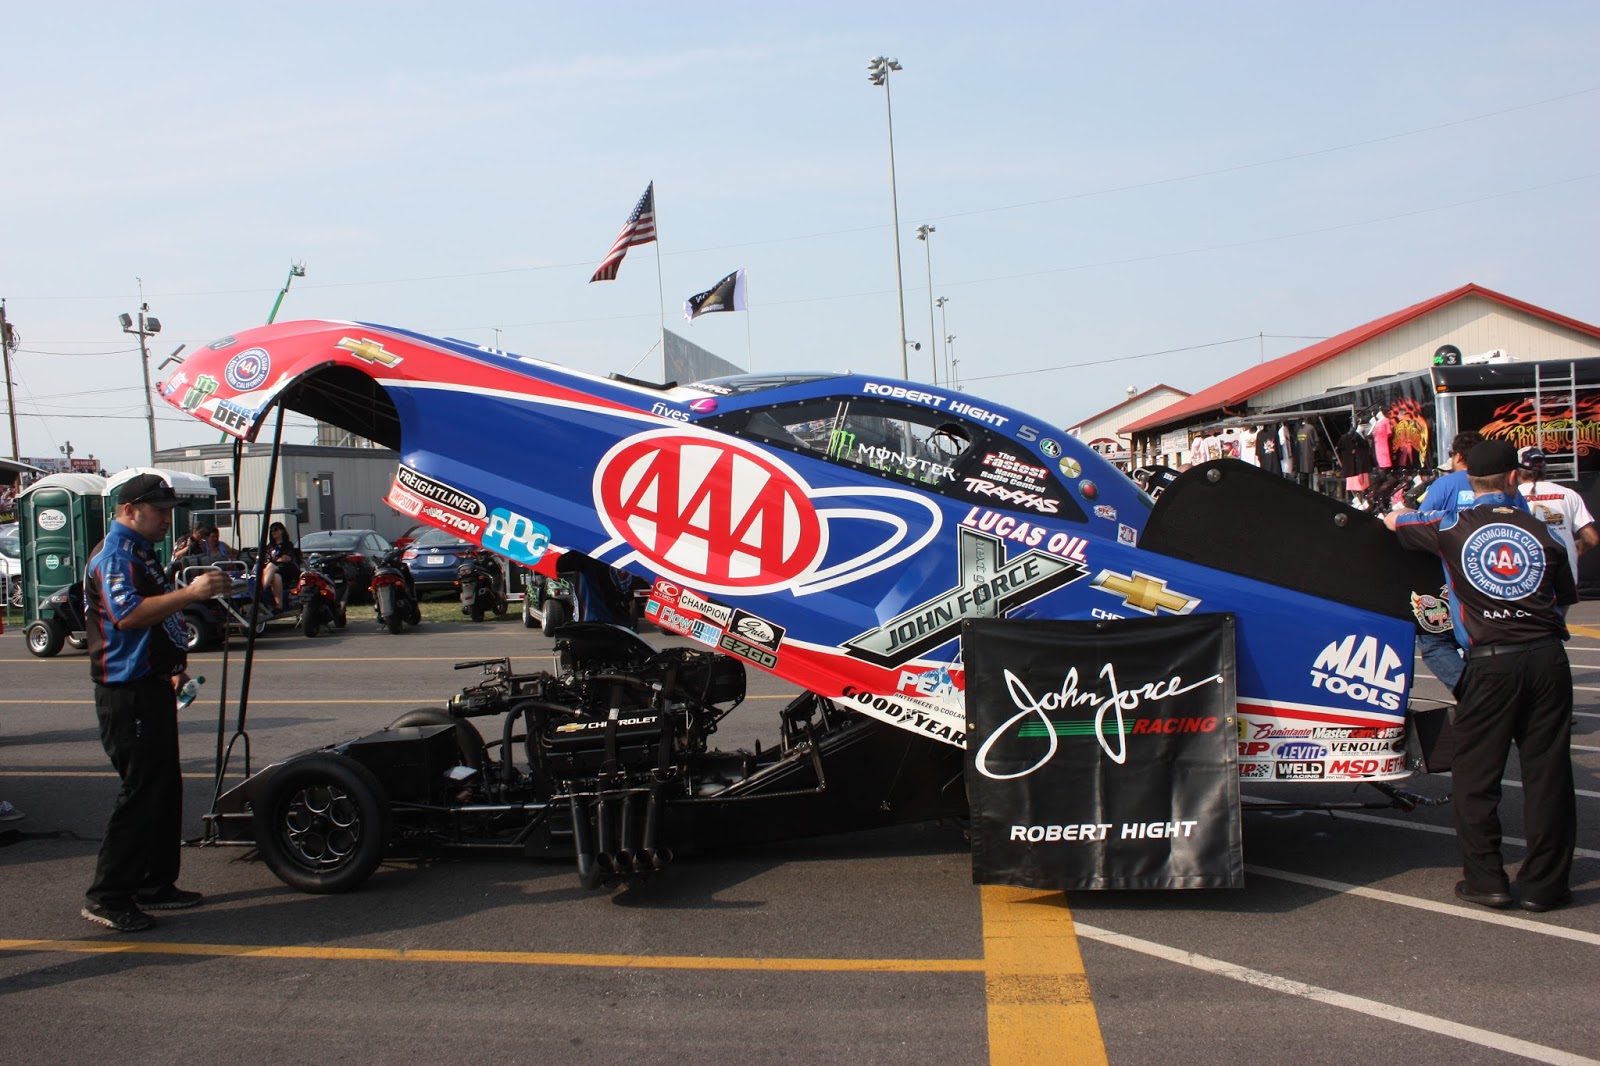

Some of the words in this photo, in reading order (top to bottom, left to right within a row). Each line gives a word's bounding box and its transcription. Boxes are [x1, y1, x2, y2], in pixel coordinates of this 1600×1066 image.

[238, 360, 257, 374] AAA
[651, 401, 690, 422] fives
[862, 382, 947, 407] ROBERT
[948, 400, 1009, 427] HIGHT
[213, 405, 247, 430] DEF
[1015, 424, 1040, 442] 5
[857, 442, 956, 482] MONSTER
[983, 453, 1047, 479] Fastest
[998, 451, 1016, 461] The
[870, 461, 940, 486] ENERGY
[980, 470, 1009, 483] Radio
[1009, 478, 1046, 493] Control
[994, 467, 1023, 480] Name
[399, 469, 477, 514] FREIGHTLINER
[963, 477, 1060, 514] TRAXXAS
[432, 508, 480, 535] ACTION
[616, 442, 804, 581] AAA
[485, 511, 549, 557] PPG
[962, 506, 1047, 547] LUCAS
[1047, 531, 1090, 561] OIL
[1469, 528, 1521, 553] AUTOMOBILE
[1520, 535, 1539, 557] CLUB
[1487, 550, 1523, 570] AAA
[1467, 556, 1503, 596] SOUTHERN
[1505, 561, 1542, 596] CALIFORNIA
[653, 590, 676, 604] KYMCO
[681, 594, 728, 622] CHAMPION
[884, 601, 954, 652] JOHN
[956, 557, 1040, 615] FORCE
[661, 606, 692, 628] Flow
[693, 620, 721, 638] main
[737, 620, 771, 640] Gates
[721, 634, 777, 667] EZGO
[1312, 634, 1405, 694] MAC
[1310, 669, 1401, 711] TOOLS
[841, 685, 966, 746] GOODYEAR
[894, 692, 934, 710] ANTIFREEZE
[940, 707, 966, 720] COOLAN
[587, 716, 659, 729] CHROLET
[974, 666, 1106, 780] John
[1094, 662, 1220, 765] Force
[1132, 716, 1218, 735] RACING
[1313, 727, 1375, 739] Mastercam
[1238, 742, 1270, 755] RP
[1331, 742, 1390, 752] VENOLIA
[1278, 763, 1323, 774] WELD
[1328, 760, 1379, 774] MSD
[1010, 823, 1113, 842] ROBERT
[1120, 820, 1198, 839] HIGHT
